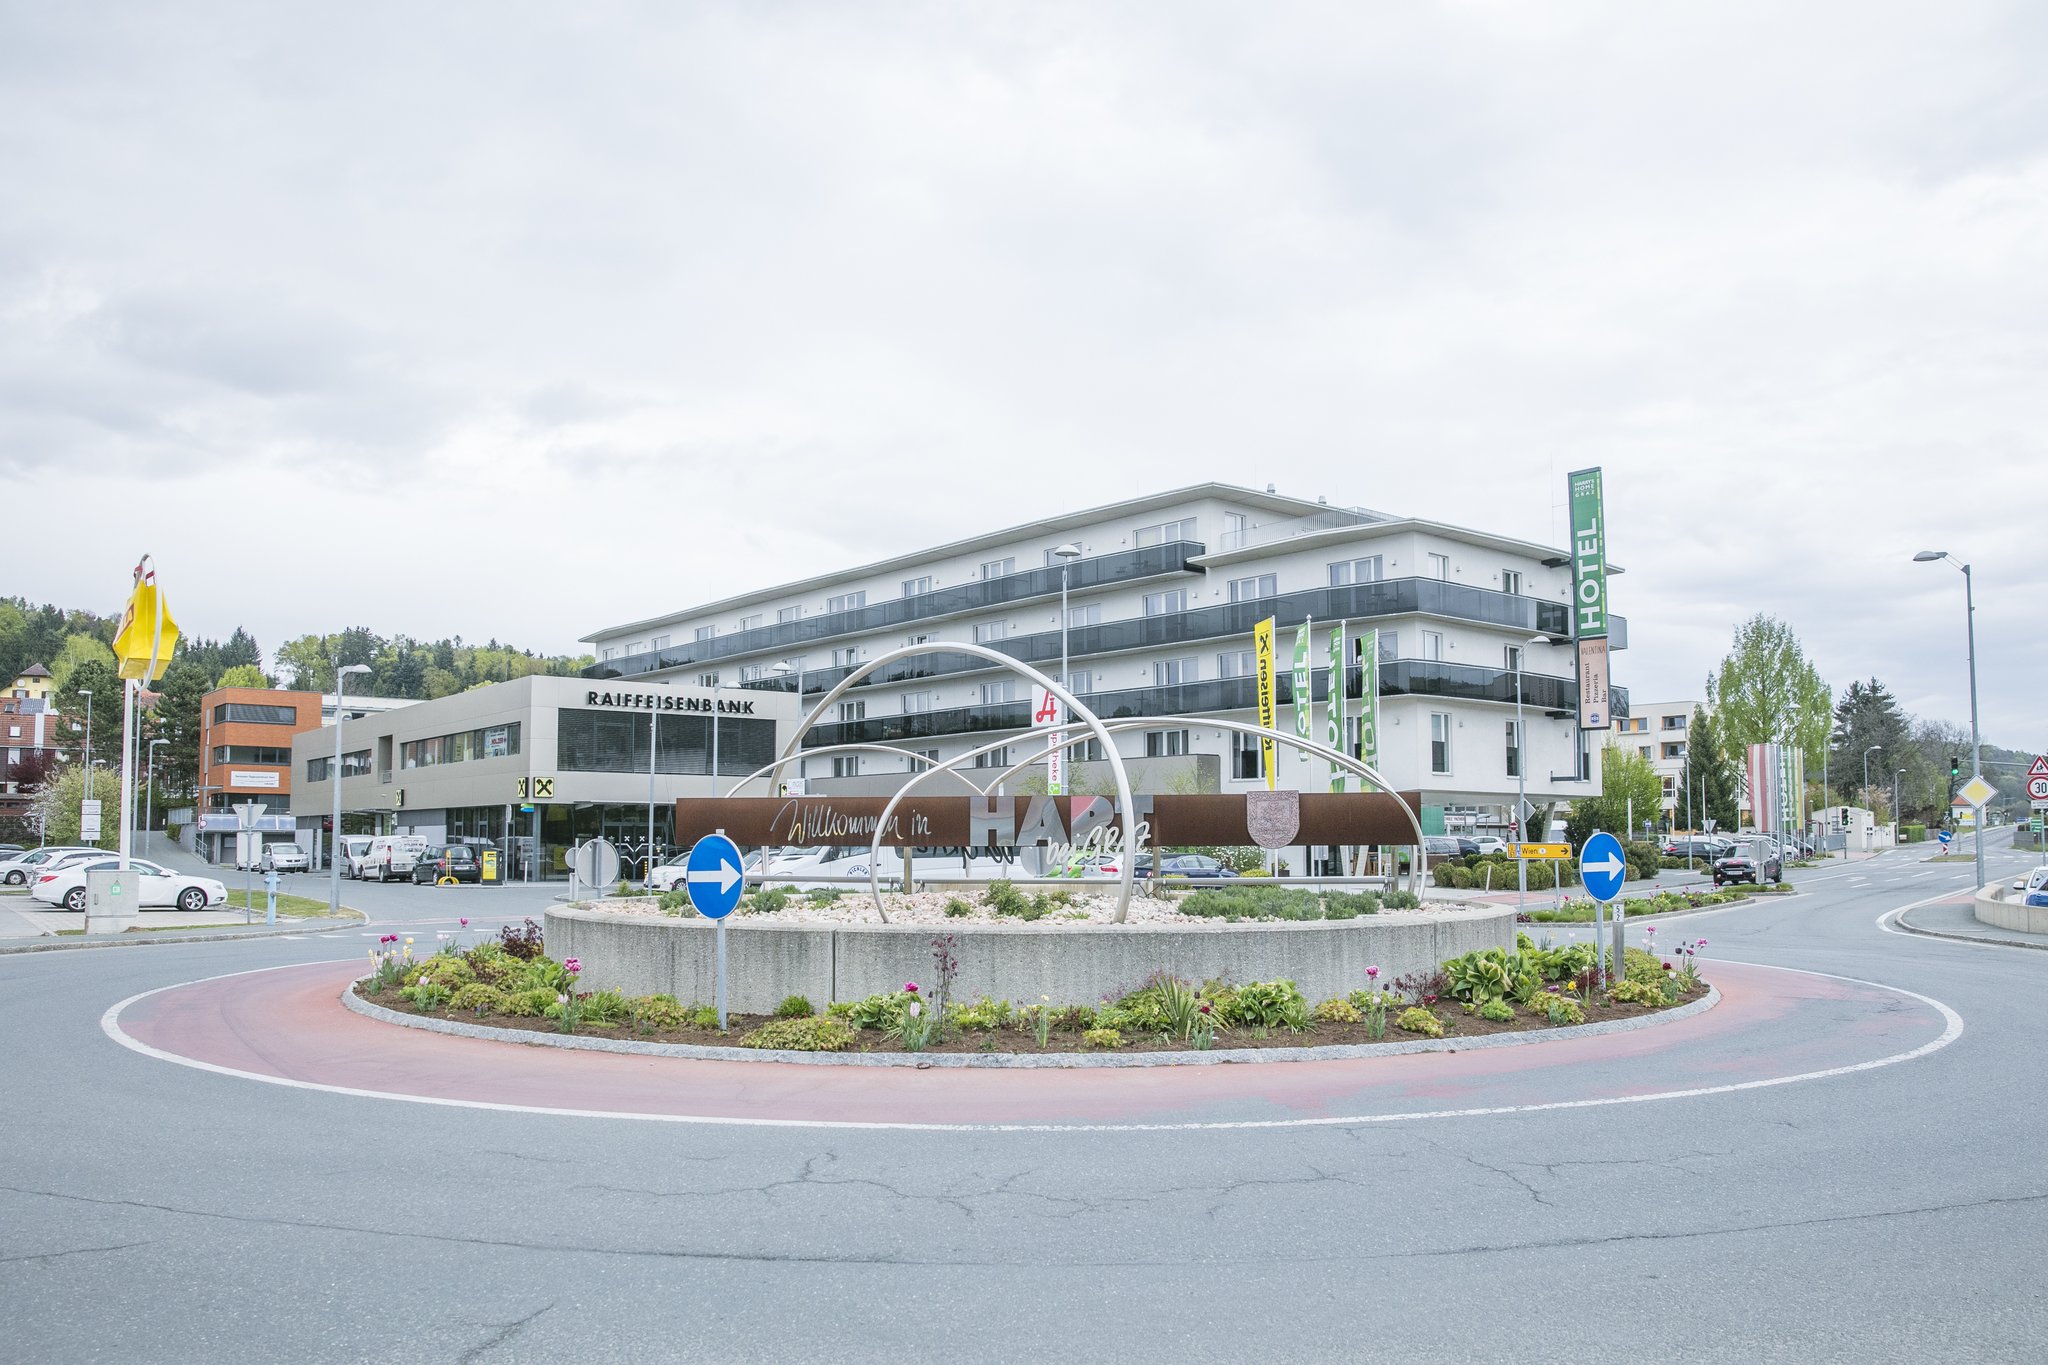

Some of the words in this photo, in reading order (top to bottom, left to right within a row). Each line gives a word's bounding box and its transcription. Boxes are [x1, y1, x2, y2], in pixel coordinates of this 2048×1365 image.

[1577, 518, 1601, 630] HOTEL
[587, 691, 755, 715] RAIFFEISENBANK
[1050, 732, 1059, 782] aptheke
[2034, 782, 2047, 794] 30
[770, 799, 904, 844] Willkommn
[911, 808, 932, 836] in
[969, 795, 1154, 847] HART
[1046, 833, 1081, 866] bei
[1522, 846, 1538, 855] Wien
